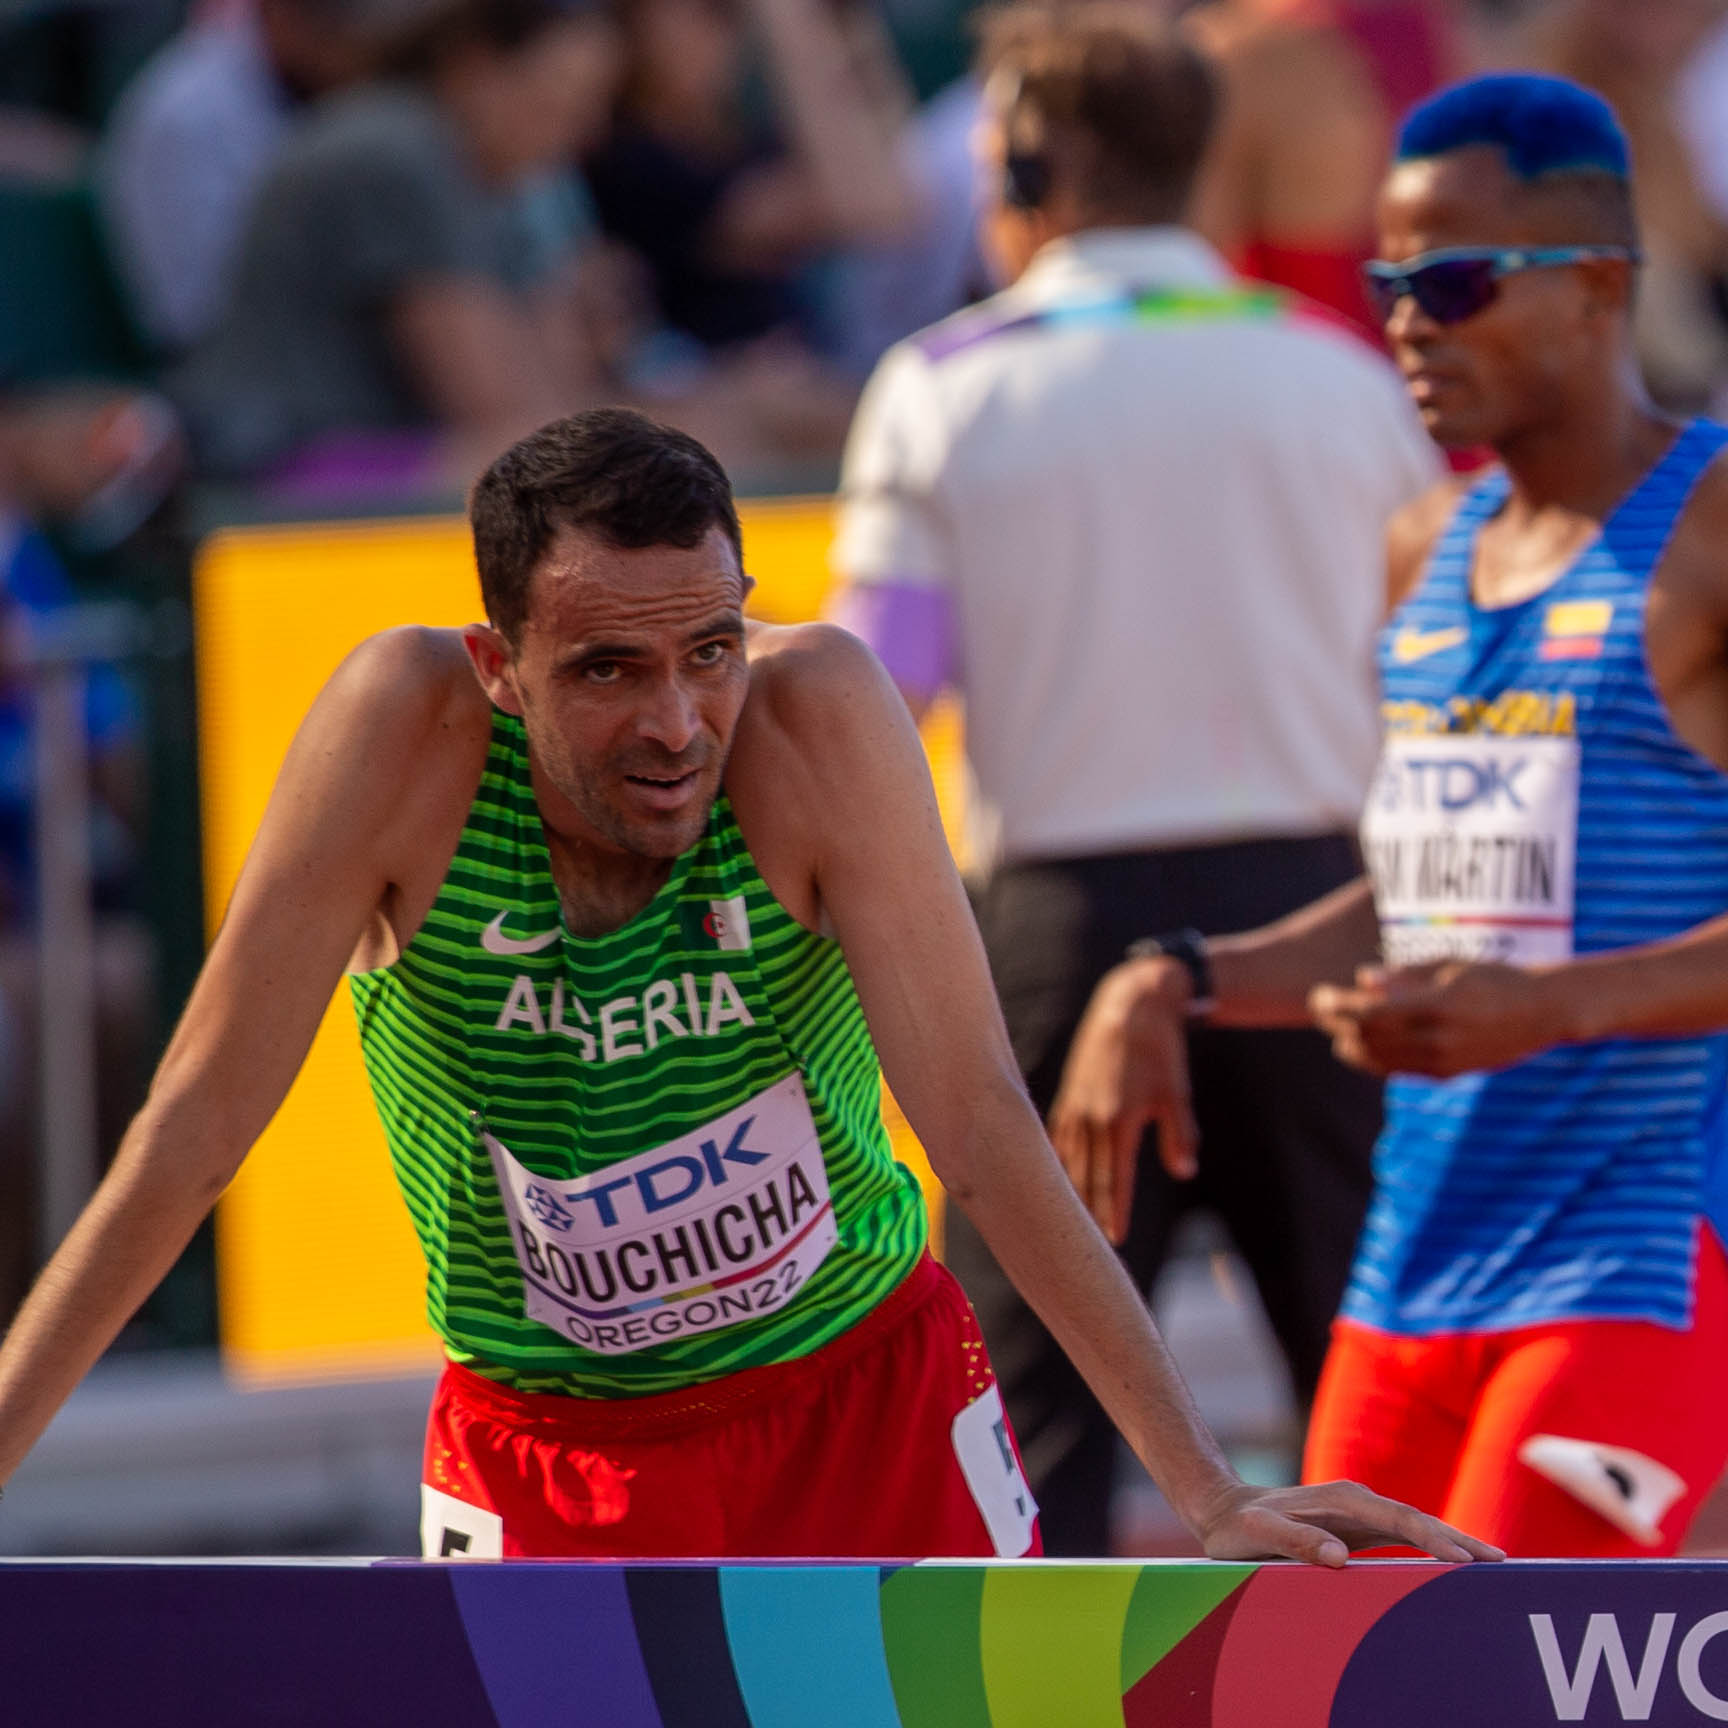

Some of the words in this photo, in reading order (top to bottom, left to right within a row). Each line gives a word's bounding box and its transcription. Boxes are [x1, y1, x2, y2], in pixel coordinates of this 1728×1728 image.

[1405, 757, 1528, 811] TDK
[565, 1115, 771, 1229] TDK
[519, 1161, 818, 1304] BOUCHICHA
[566, 1259, 803, 1348] OREGON22
